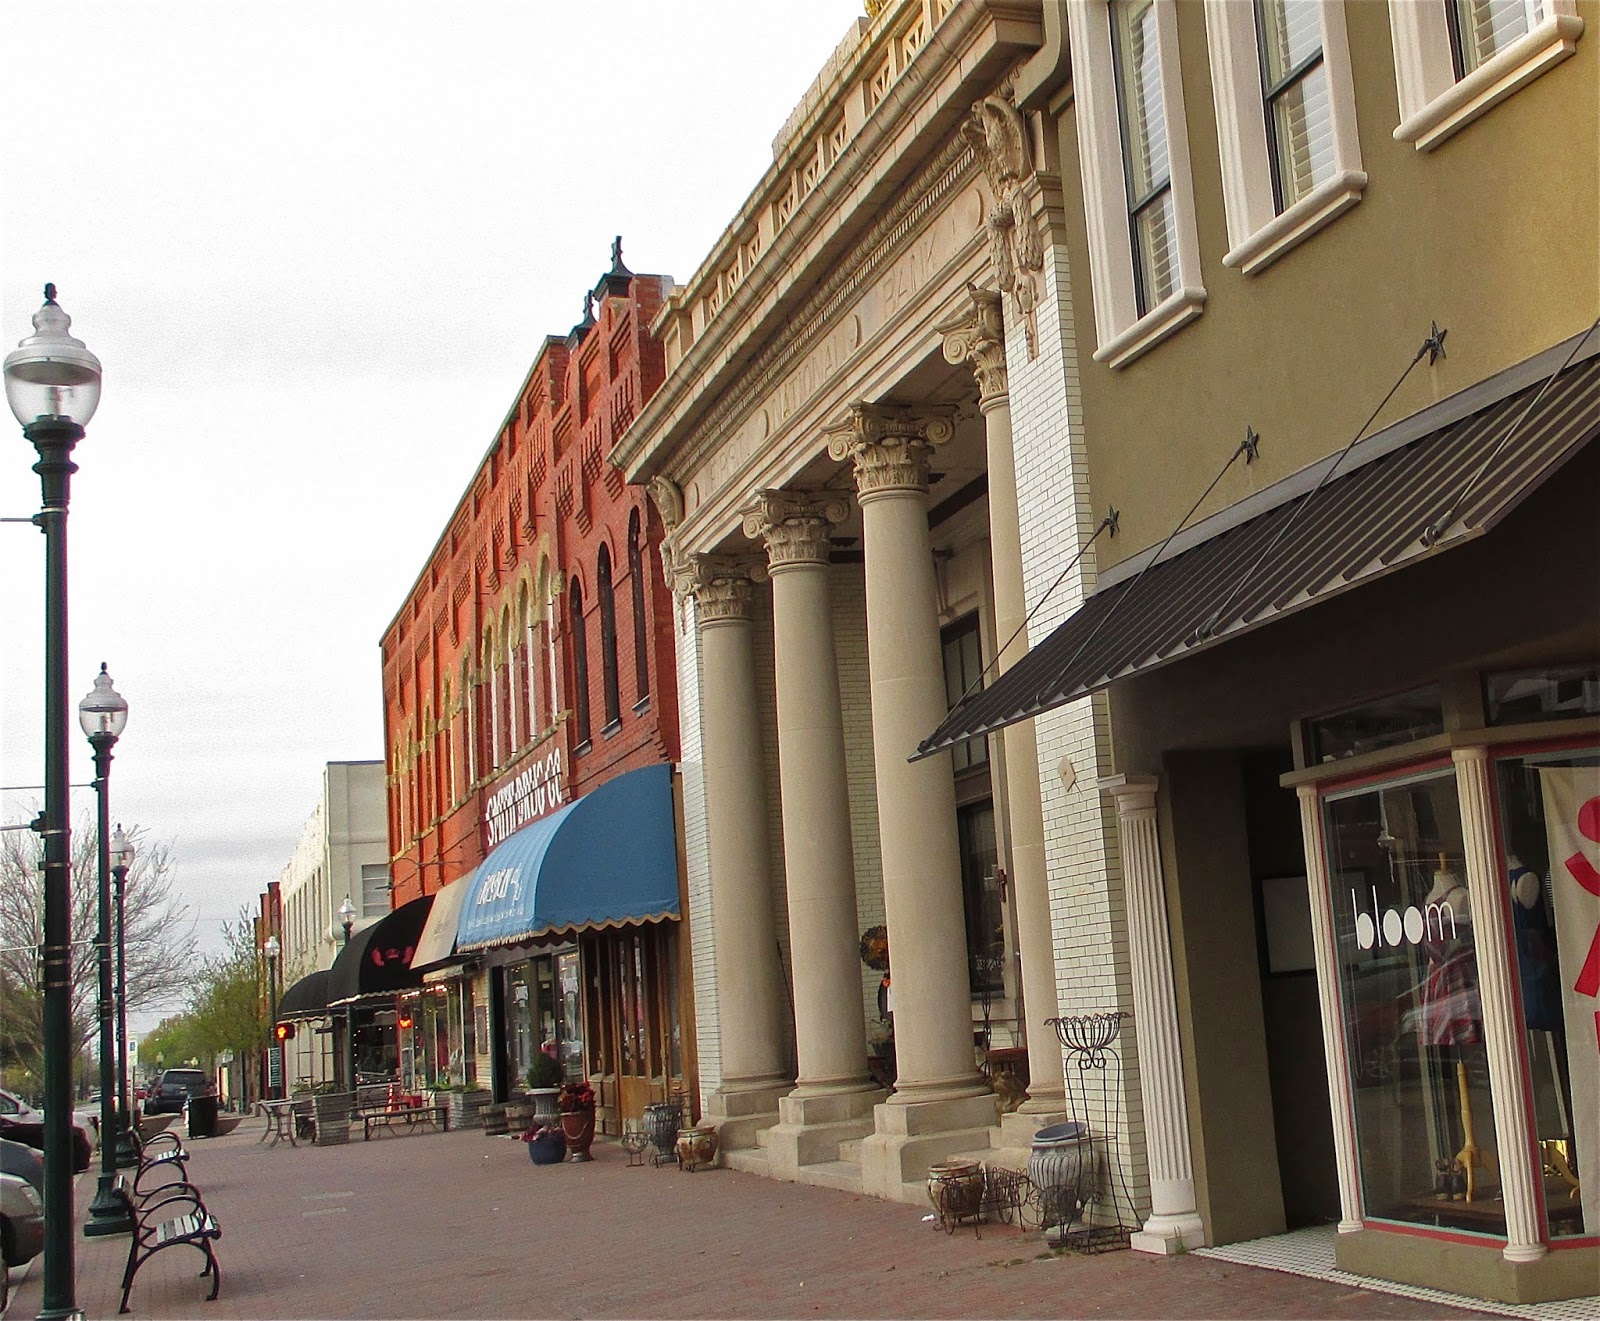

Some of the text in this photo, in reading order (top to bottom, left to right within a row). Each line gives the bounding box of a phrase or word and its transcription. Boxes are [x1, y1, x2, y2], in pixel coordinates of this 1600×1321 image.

[882, 231, 938, 320] BANK
[485, 780, 517, 847] SMITH
[515, 760, 546, 826] DRUG
[1351, 885, 1456, 950] bloom
